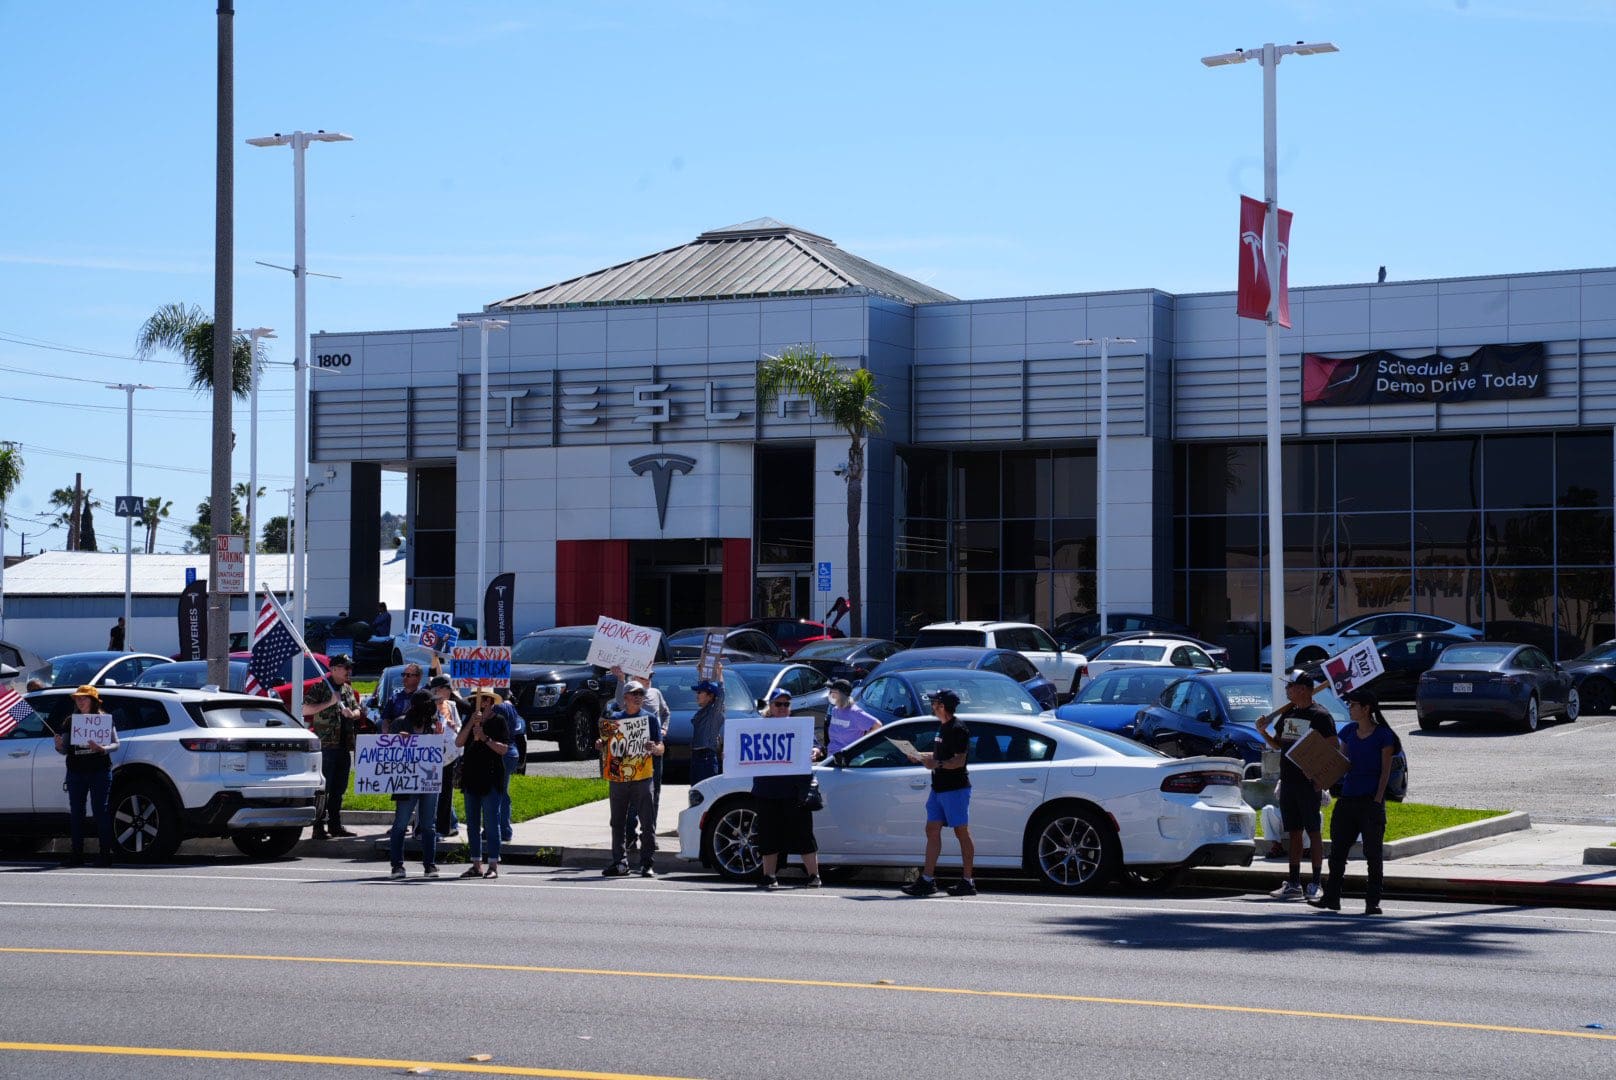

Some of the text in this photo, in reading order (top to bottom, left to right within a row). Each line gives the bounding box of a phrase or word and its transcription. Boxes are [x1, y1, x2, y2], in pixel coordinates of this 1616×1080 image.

[317, 353, 352, 368] 1800
[1377, 360, 1469, 376] Schedule a
[1376, 372, 1538, 393] Demo Drive Today
[488, 381, 818, 428] TESLA
[118, 499, 129, 513] A
[133, 500, 142, 513] A
[217, 536, 228, 550] NO
[218, 551, 243, 563] PARKING
[412, 611, 451, 625] FUCK
[498, 600, 506, 630] PARKING
[189, 608, 202, 662] ELIVERIES
[598, 622, 634, 643] HONK
[453, 661, 509, 677] FIRE MUSK
[85, 716, 102, 726] NO
[624, 720, 641, 731] THIS
[375, 734, 419, 748] SAVE
[628, 728, 646, 740] NOT
[739, 732, 796, 762] RESIST
[358, 746, 443, 764] AMERICAN JOBS
[374, 761, 420, 776] DEPORT
[357, 777, 380, 793] the
[385, 775, 419, 793] NAZI
